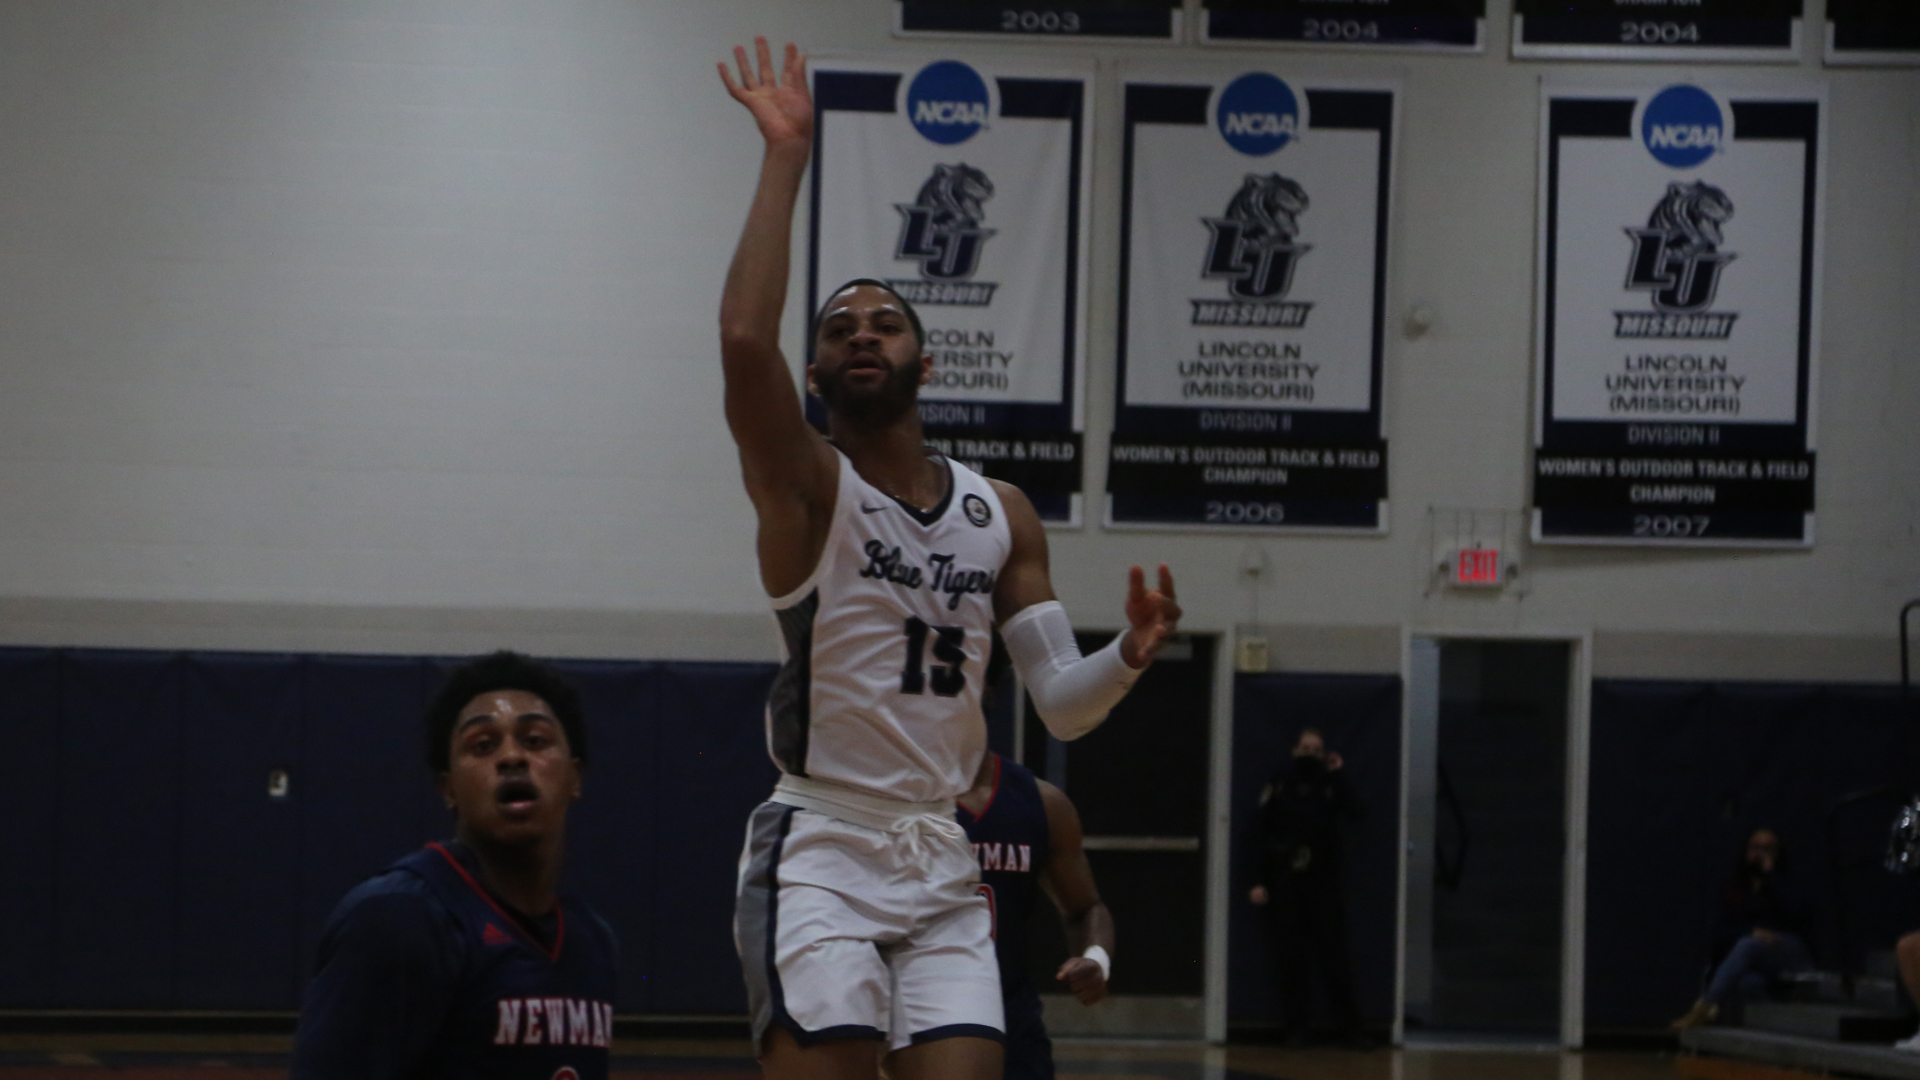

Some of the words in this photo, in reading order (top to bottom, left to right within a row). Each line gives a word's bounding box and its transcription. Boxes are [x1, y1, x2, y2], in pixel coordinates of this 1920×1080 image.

[1001, 9, 1080, 32] 2003
[1303, 18, 1379, 40] 2004
[1620, 20, 1700, 43] 2004
[914, 100, 989, 126] NCAA
[1224, 111, 1297, 138] NCAA
[1649, 122, 1722, 149] NCAA
[1195, 303, 1306, 325] MISSOURI
[1618, 315, 1732, 337] MISSOURI
[925, 329, 995, 349] COLN
[930, 349, 1014, 369] ERSITY
[1199, 341, 1302, 360] LINCOLN
[1178, 360, 1320, 380] UNIVERSITY
[1625, 354, 1727, 373] LINCOLN
[929, 370, 1010, 392] SOURI)
[1182, 381, 1316, 401] (MISSOURI)
[1605, 374, 1747, 394] UNIVERSITY
[972, 405, 986, 426] II
[1609, 395, 1741, 415] (MISSOURI)
[1199, 411, 1278, 432] DIVISION
[1280, 413, 1292, 432] II
[1626, 425, 1704, 445] DIVISION
[1708, 426, 1721, 446] II
[956, 440, 1010, 461] TRACK
[1012, 442, 1026, 461] &
[1029, 442, 1075, 462] FIELD
[1111, 443, 1190, 464] WOMEN'S
[1193, 446, 1267, 466] OUTDOOR
[1271, 448, 1320, 467] TRACK
[1322, 450, 1336, 467] &
[1339, 450, 1380, 469] FIELD
[1202, 466, 1289, 486] CHAMPION
[1538, 456, 1616, 477] WOMEN'S
[1618, 458, 1694, 479] OUTDOOR
[1697, 460, 1747, 480] TRACK
[1750, 461, 1764, 480] &
[1766, 461, 1810, 481] FIELD
[1628, 483, 1717, 505] CHAMPION
[1205, 501, 1285, 523] 2006
[1632, 514, 1712, 537] 2007
[860, 539, 923, 589] Blue
[1459, 549, 1499, 583] EXIT
[900, 616, 967, 698] 15
[972, 841, 1032, 873] MAN
